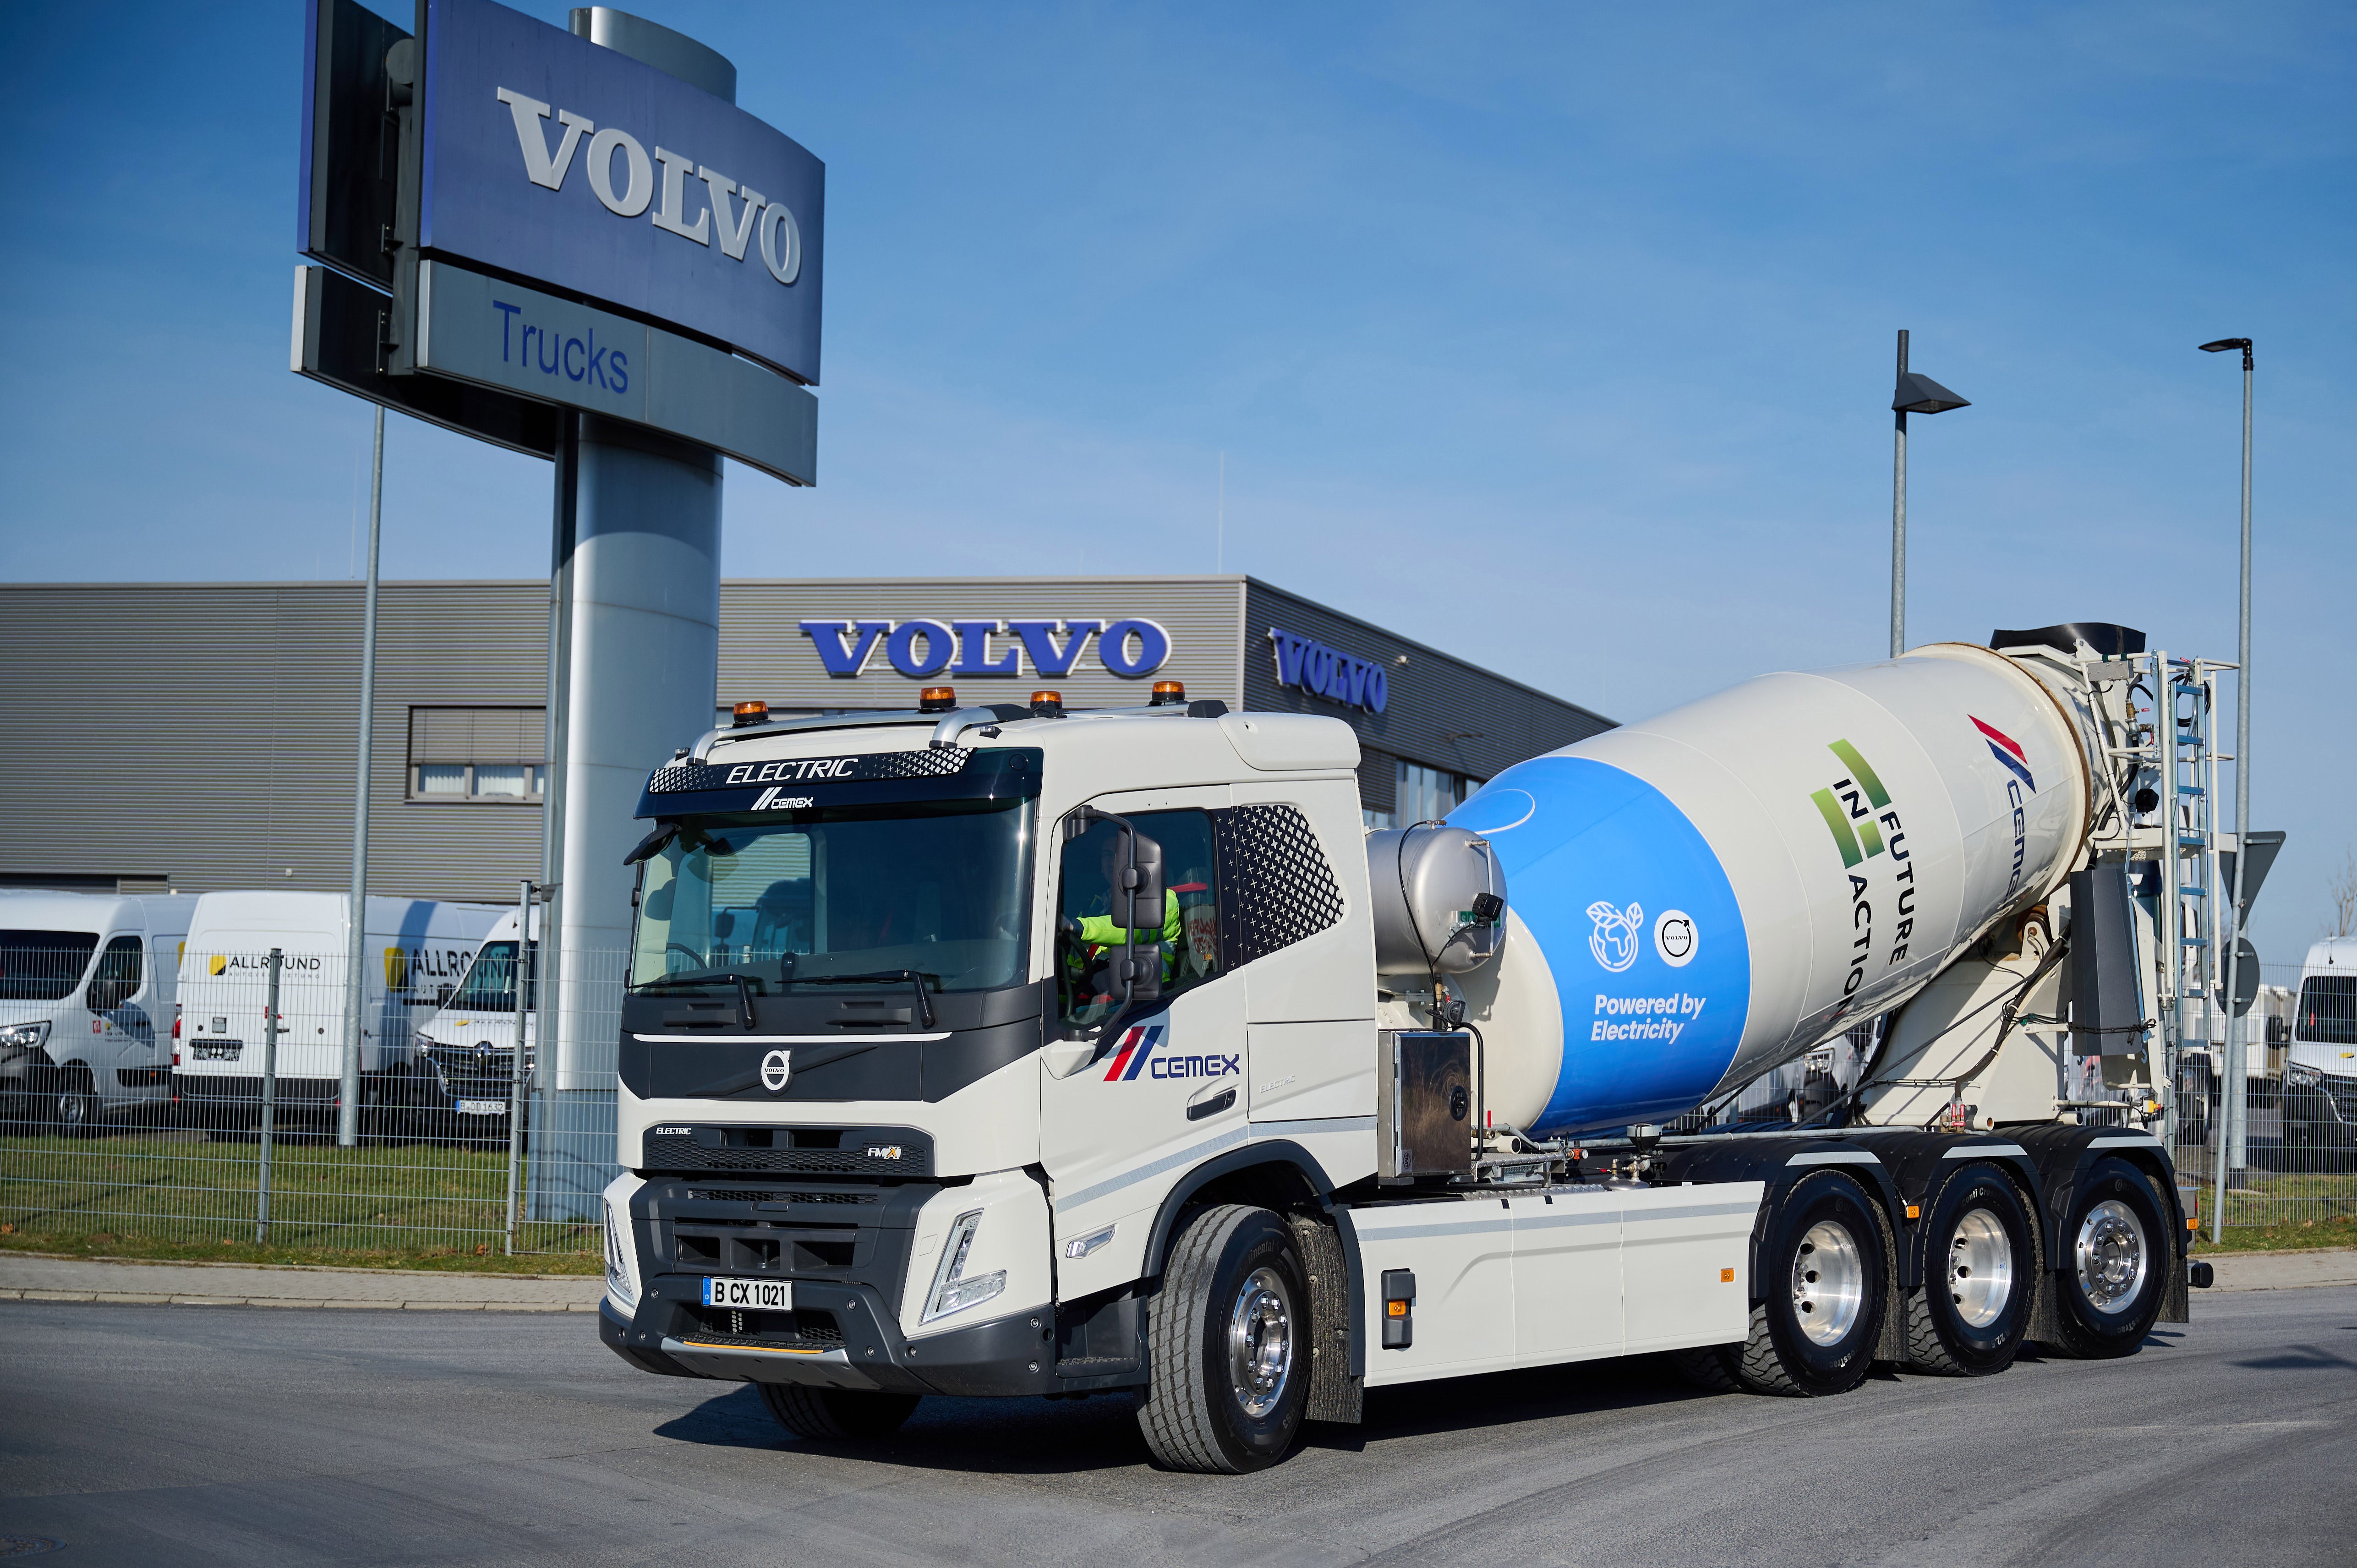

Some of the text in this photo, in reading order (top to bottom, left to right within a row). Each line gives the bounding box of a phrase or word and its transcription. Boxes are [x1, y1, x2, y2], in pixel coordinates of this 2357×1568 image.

[497, 86, 801, 284] VOLVO
[493, 300, 628, 393] Trucks
[799, 618, 1172, 679] VOLVO
[1268, 627, 1388, 714] VOLVO
[726, 758, 859, 784] ELECTRIC
[771, 797, 814, 809] CEMEX
[1833, 778, 1869, 819] IN
[1880, 811, 1914, 966] FUTURE
[1830, 874, 1871, 1022] ACTION
[230, 956, 320, 970] ALLRUND
[1595, 993, 1706, 1020] Powered by
[1591, 1017, 1684, 1044] Electricity
[1151, 1054, 1240, 1079] CEMEX
[1260, 1075, 1296, 1093] ELECTRIC
[868, 1147, 901, 1159] FMX
[1962, 1188, 1978, 1207] Conti
[715, 1282, 725, 1303] B
[730, 1283, 750, 1304] CX
[755, 1284, 785, 1306] 1021
